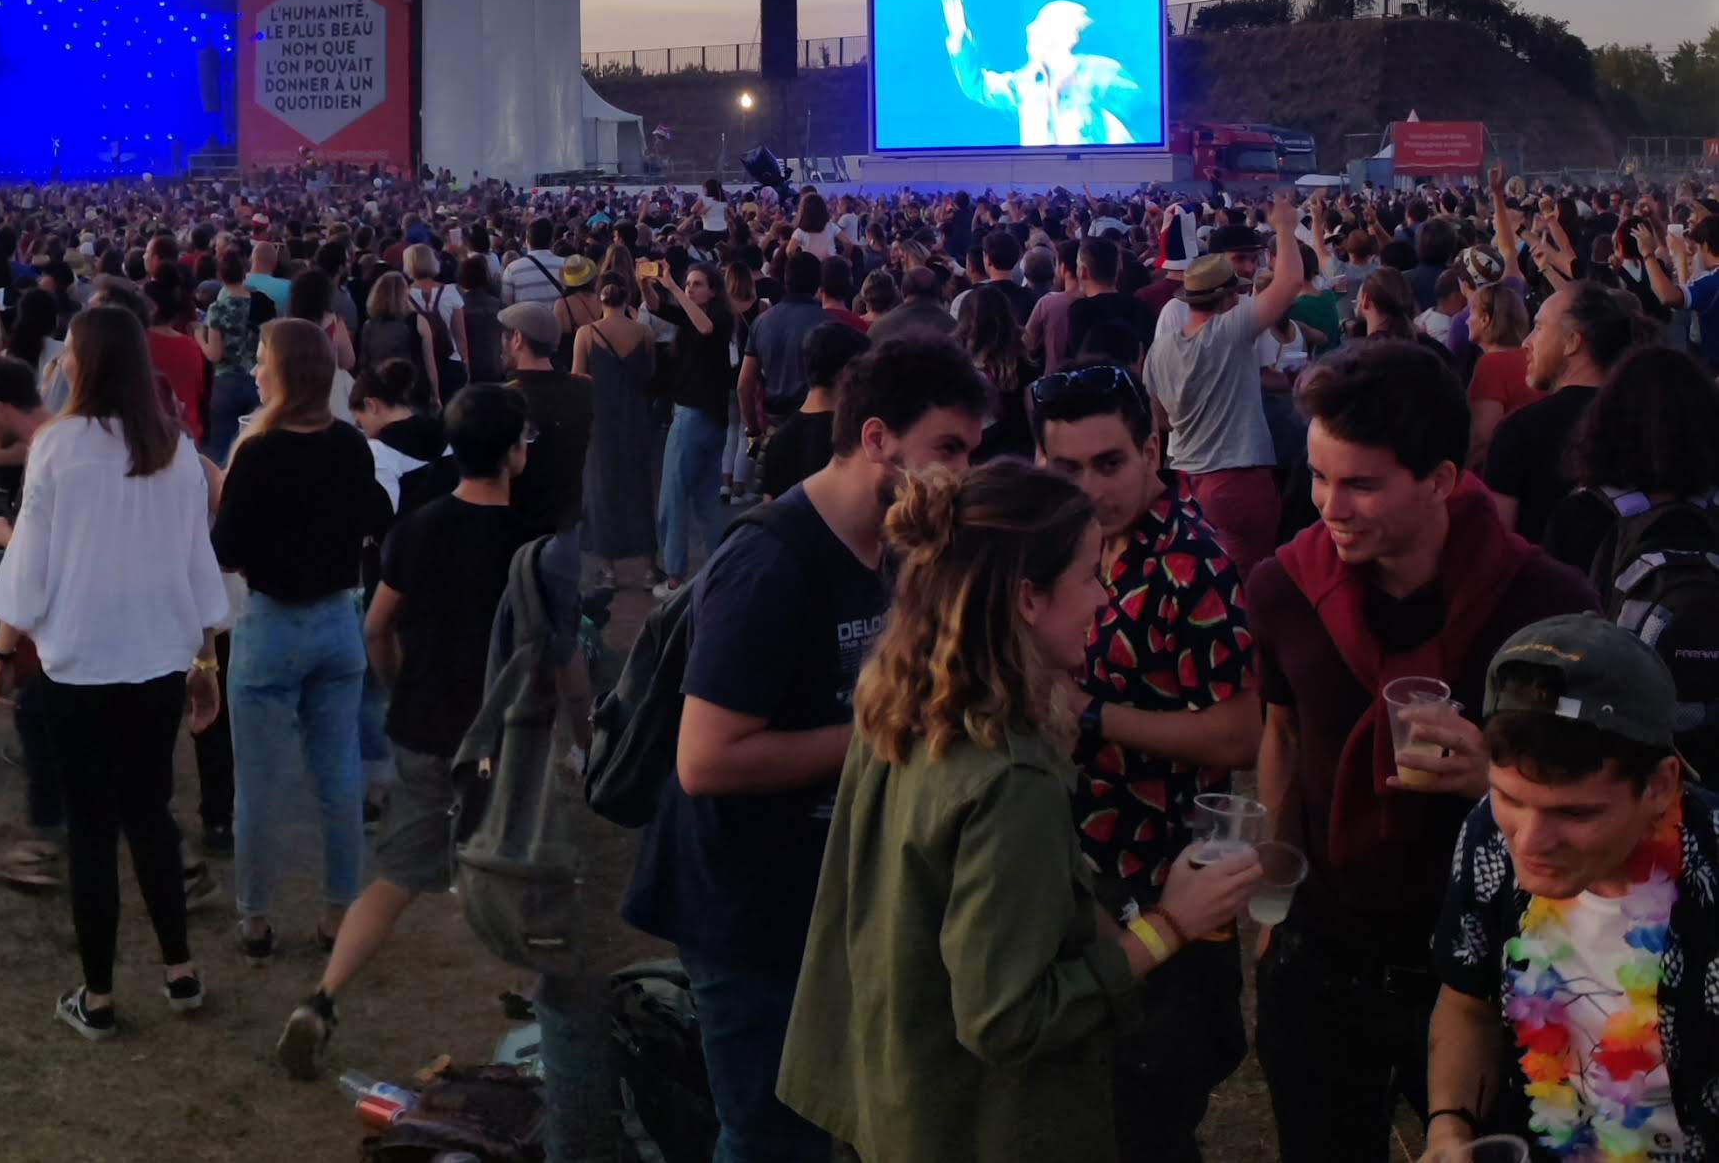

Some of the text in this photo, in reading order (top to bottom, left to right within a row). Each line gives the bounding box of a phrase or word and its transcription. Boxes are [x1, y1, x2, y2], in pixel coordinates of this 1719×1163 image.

[271, 0, 369, 22] L'HUMANITÉ,
[267, 21, 374, 39] LE PLUS BEAU
[282, 40, 356, 56] NOM QUE
[266, 58, 373, 75] L'ON POUVAIT
[265, 73, 374, 93] DONNER À UN
[275, 94, 362, 112] QUOTIDIEN
